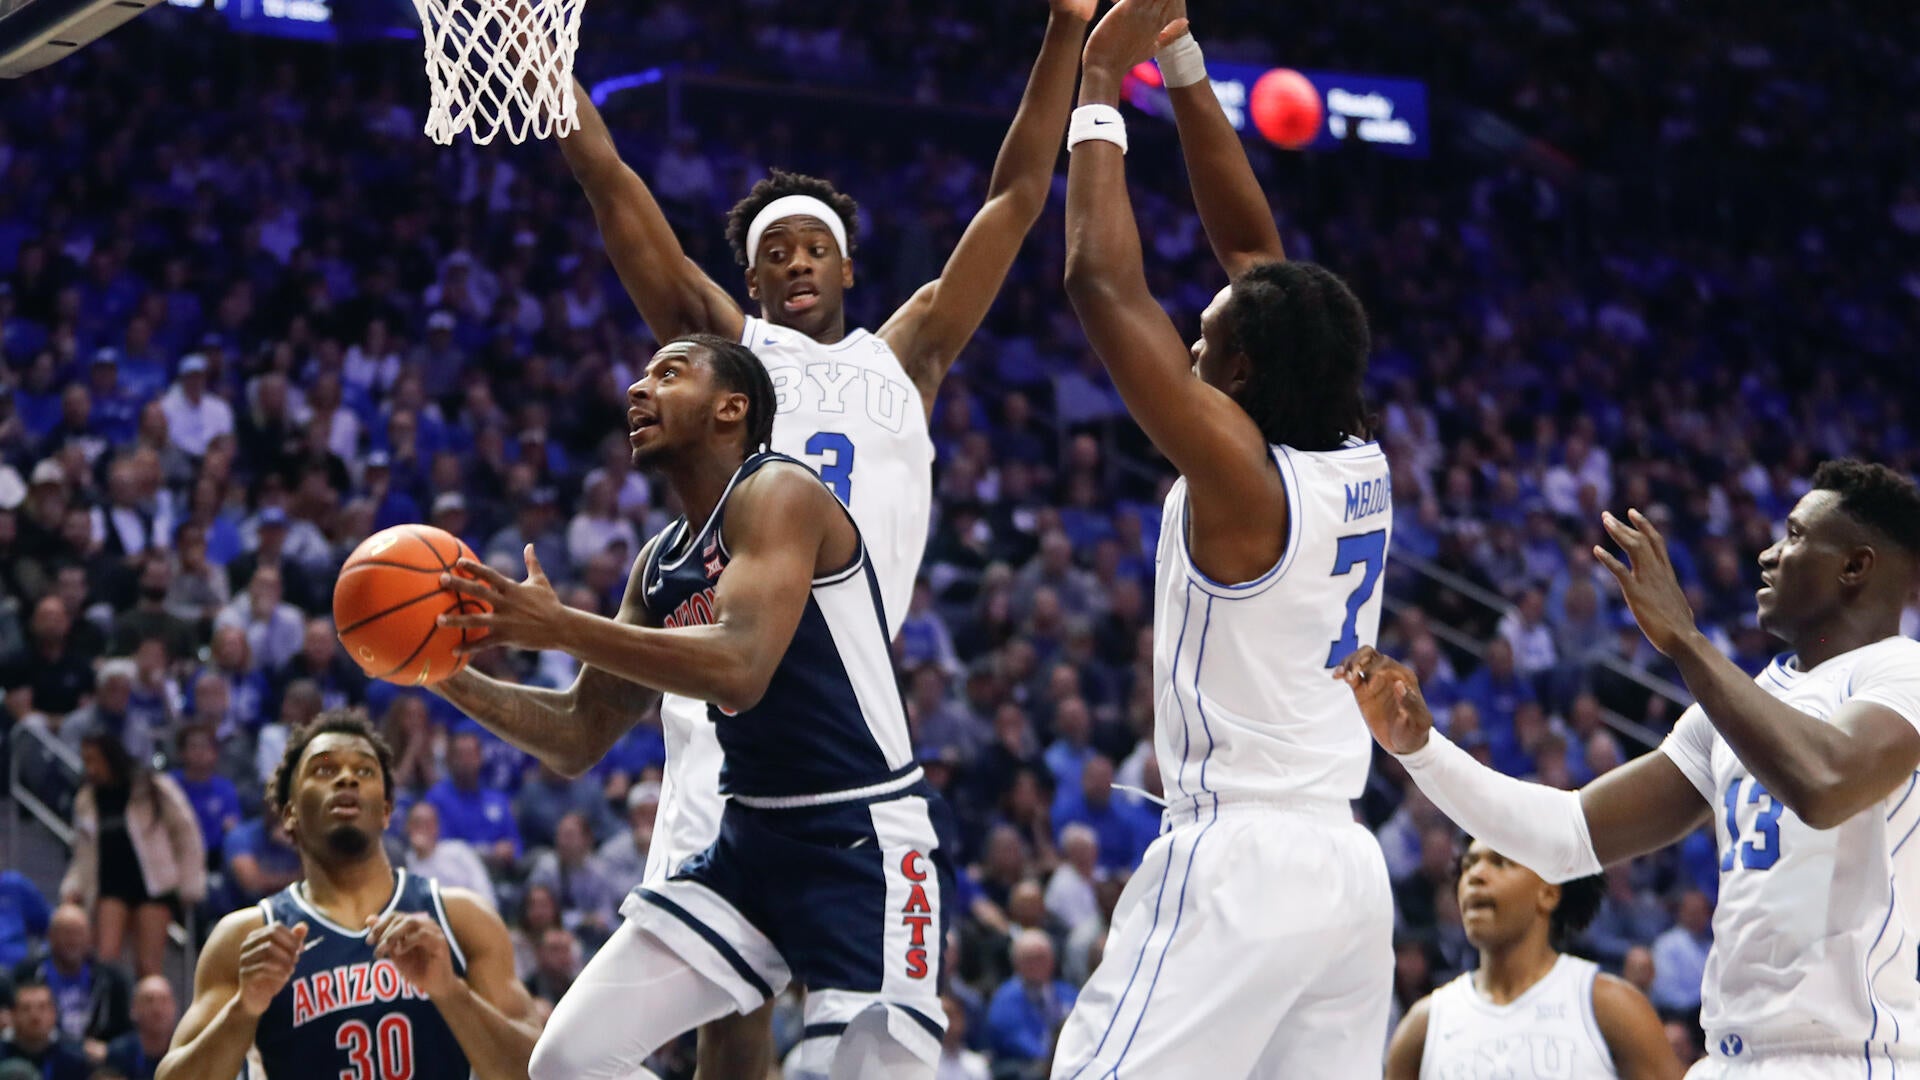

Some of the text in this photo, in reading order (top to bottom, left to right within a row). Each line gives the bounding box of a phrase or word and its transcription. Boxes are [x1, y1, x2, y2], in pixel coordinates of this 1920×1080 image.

[767, 362, 909, 434] BYU
[805, 432, 855, 508] 3
[1325, 528, 1386, 669] 7
[1720, 778, 1784, 873] 13
[901, 850, 932, 979] CATS
[336, 1012, 415, 1080] 30
